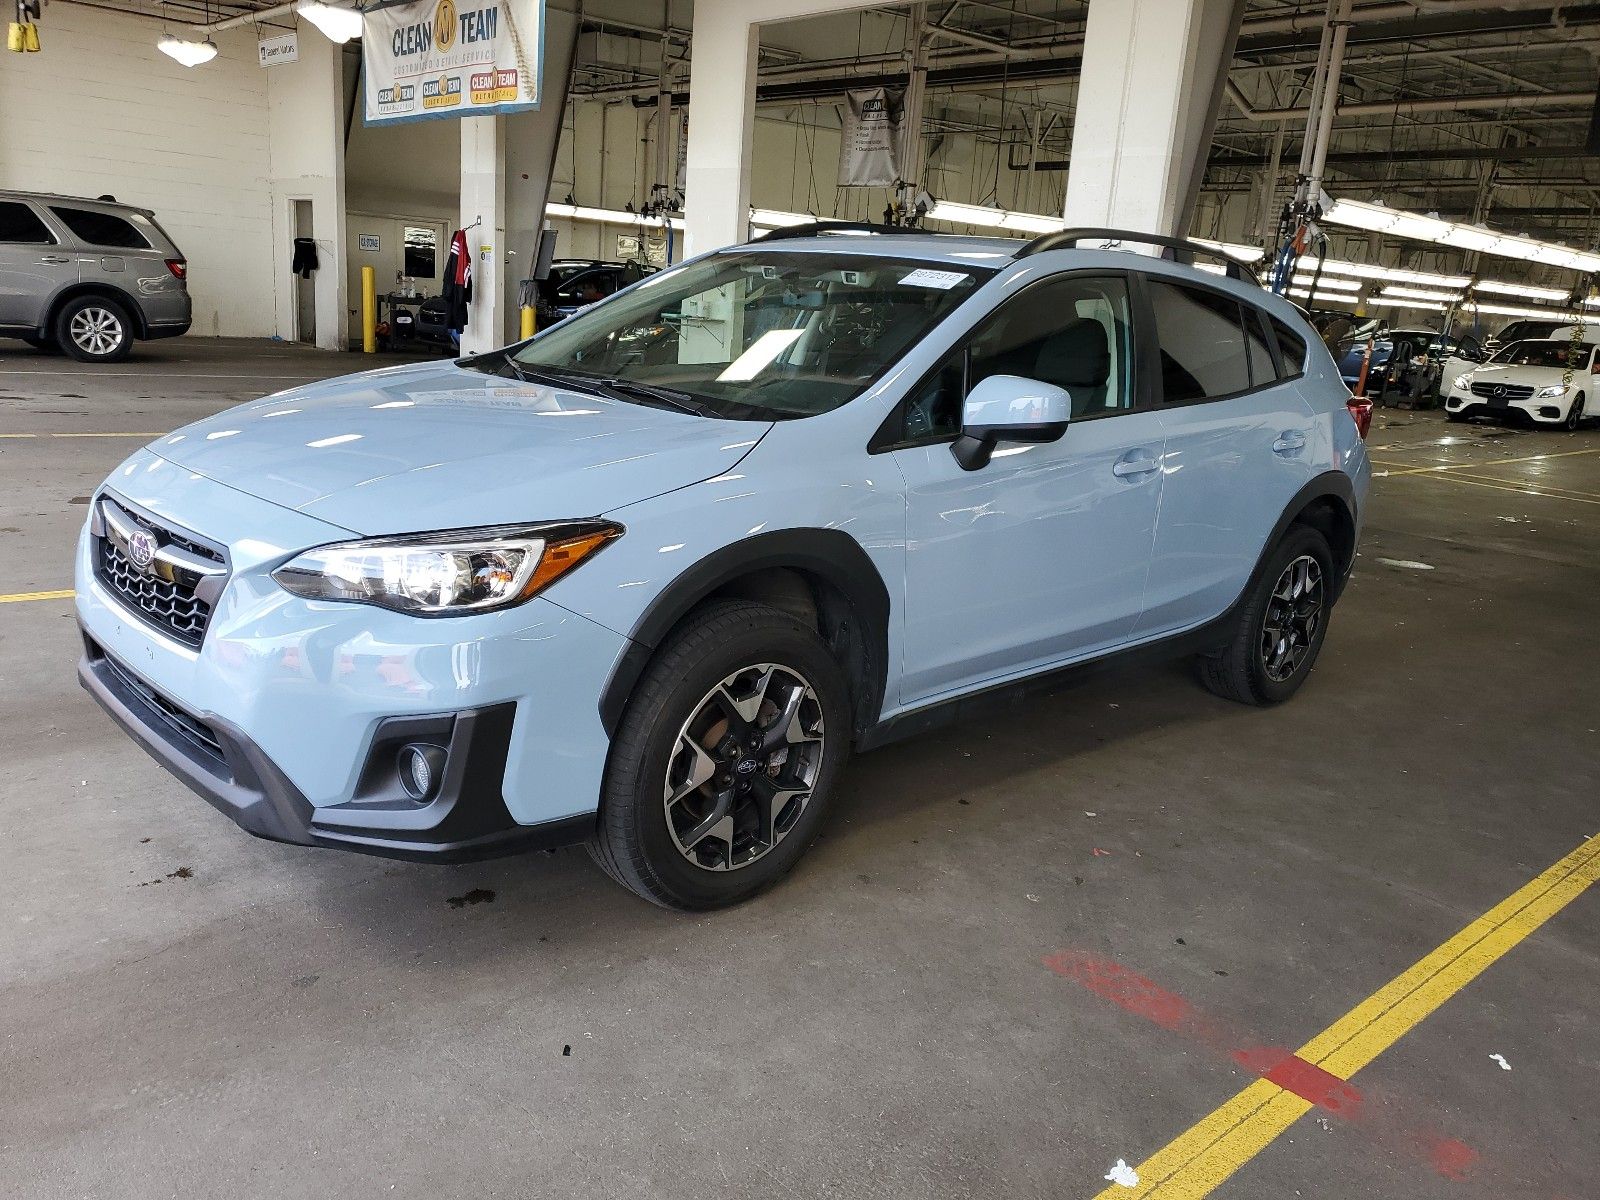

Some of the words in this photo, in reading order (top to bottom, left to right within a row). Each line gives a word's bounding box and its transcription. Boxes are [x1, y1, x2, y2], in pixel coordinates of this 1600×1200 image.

[392, 21, 432, 58] CLEAN
[459, 6, 498, 45] TEAM
[423, 80, 439, 96] CLEAN
[447, 77, 460, 93] TEAM
[472, 74, 493, 89] CLEAN
[497, 72, 516, 88] TEAM
[379, 90, 394, 103] CLEAN
[401, 86, 414, 100] TEAM
